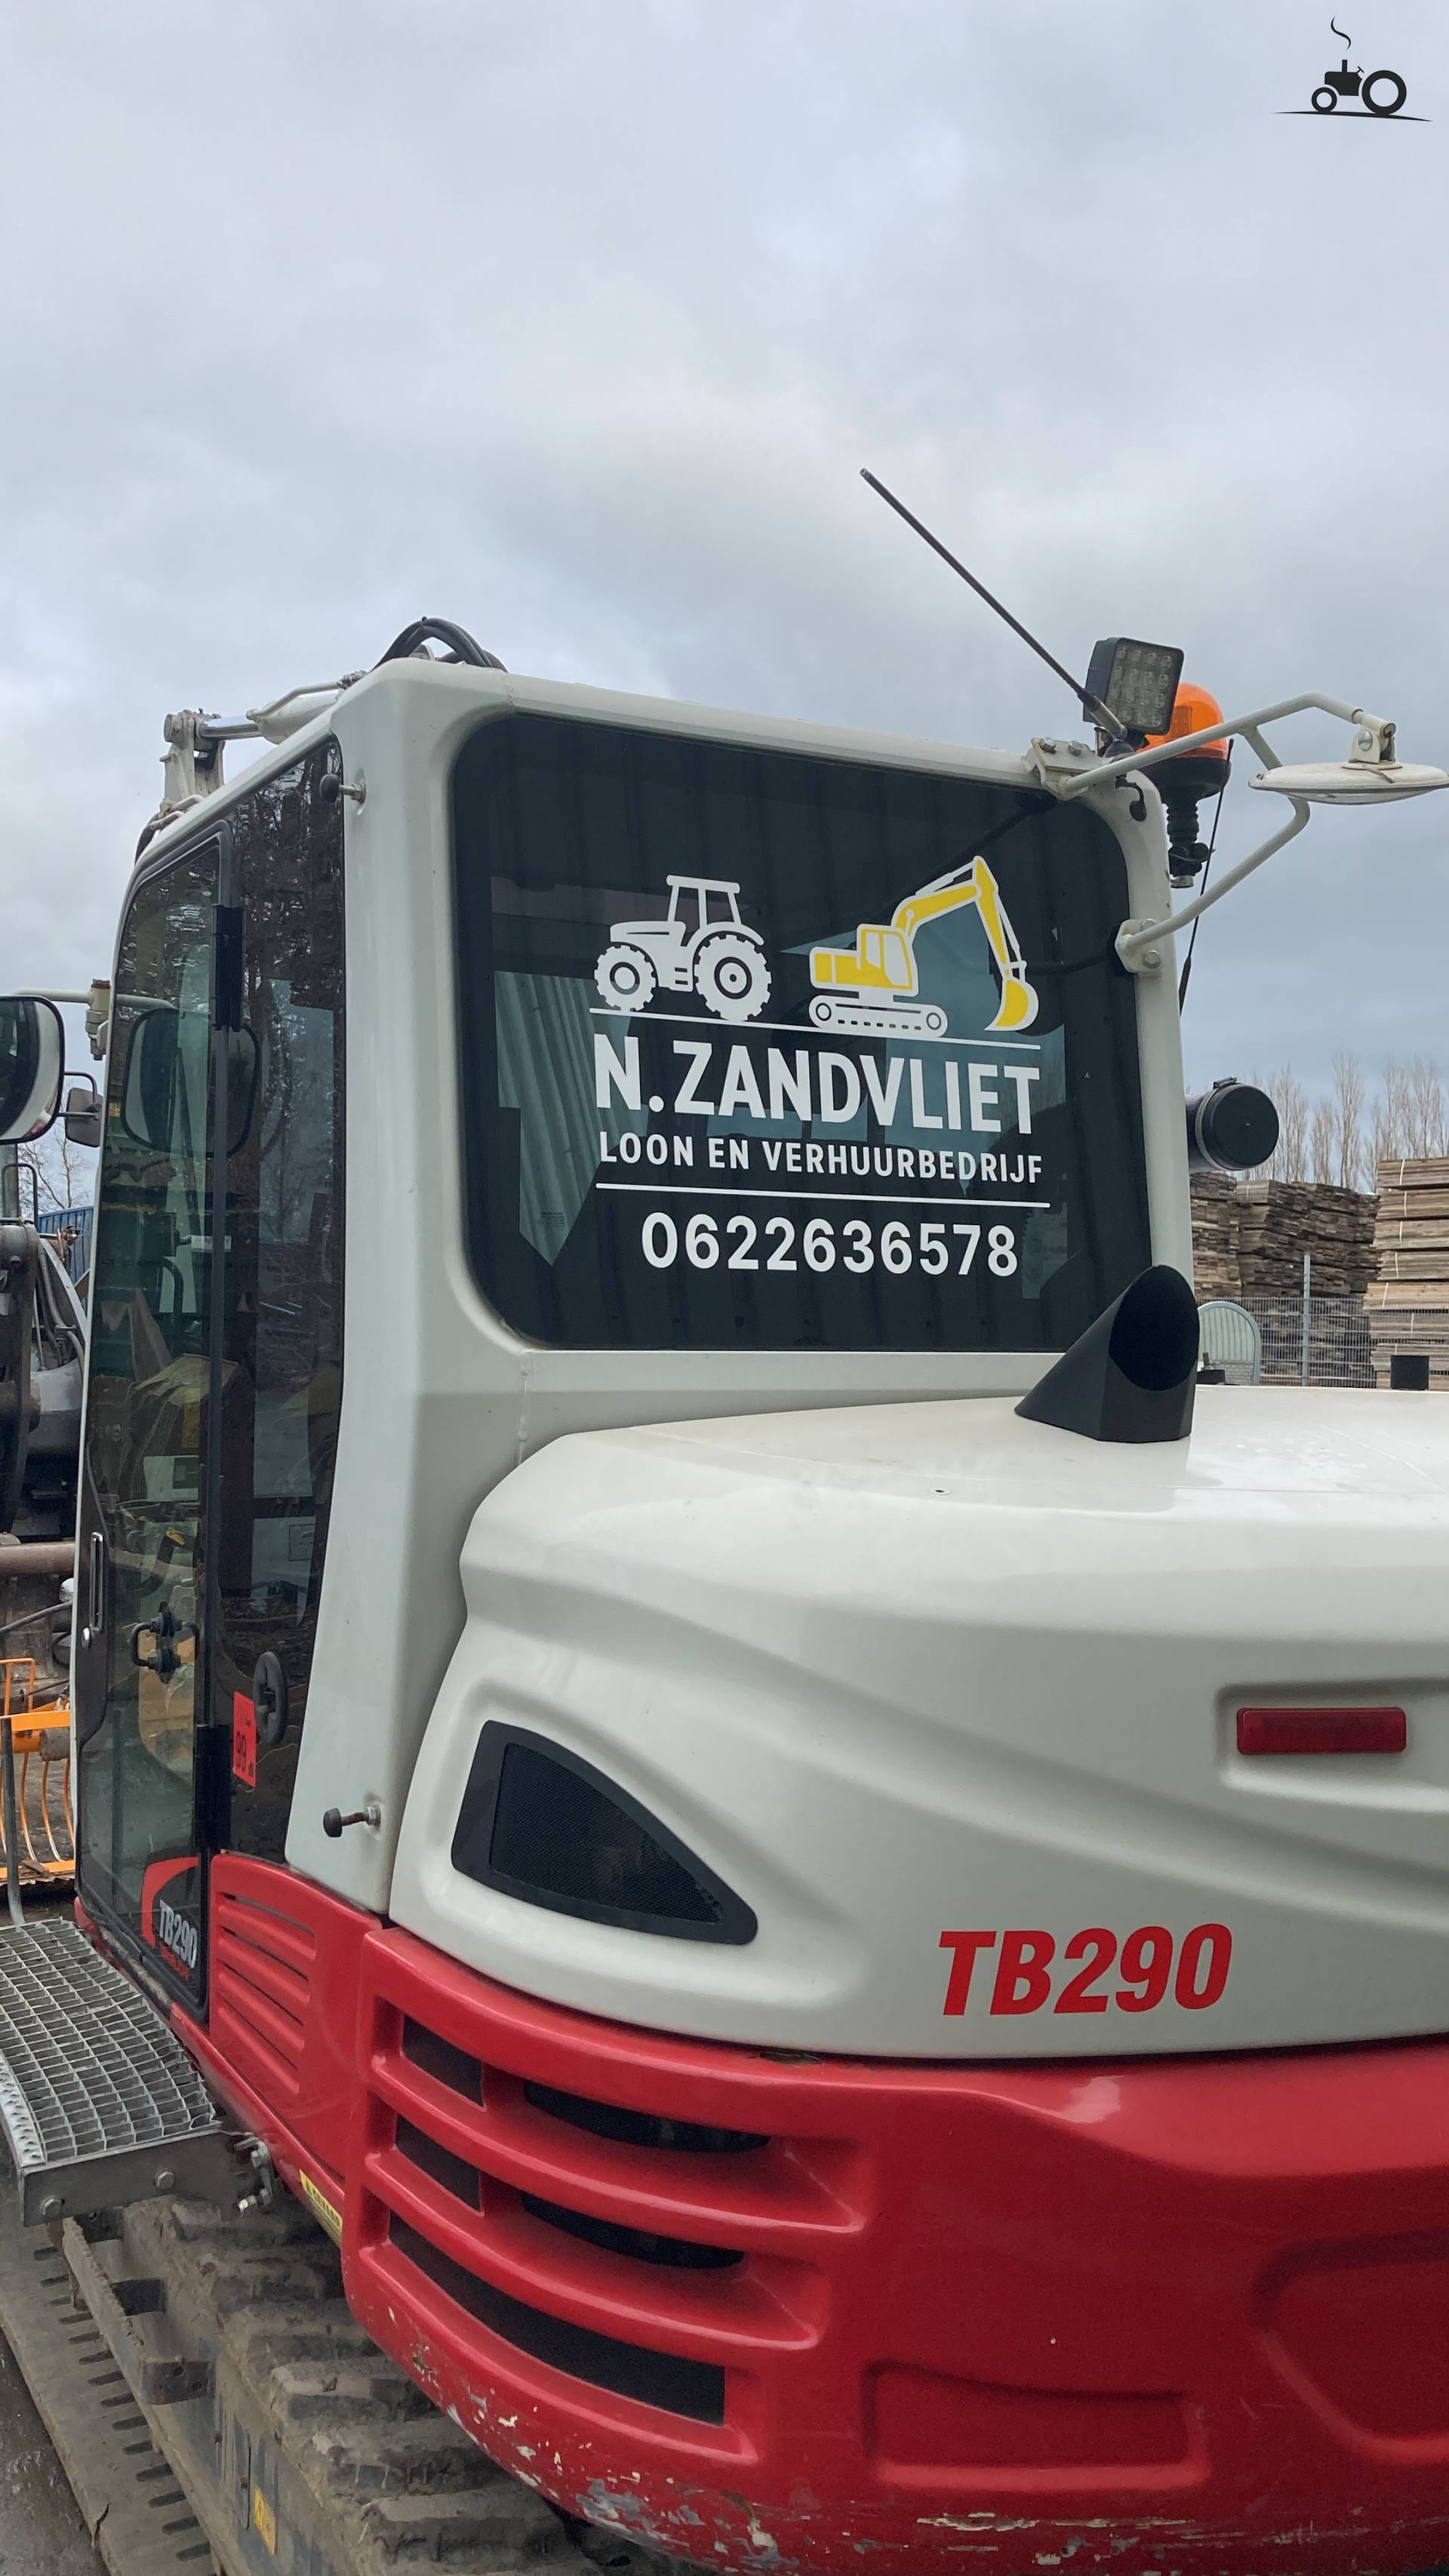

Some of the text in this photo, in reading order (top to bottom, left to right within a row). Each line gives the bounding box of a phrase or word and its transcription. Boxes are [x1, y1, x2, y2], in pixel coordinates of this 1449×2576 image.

[600, 1131, 1042, 1183] LOON EN VERHUURBEDRIJF
[641, 1212, 1018, 1277] 0622636578
[159, 1899, 198, 1968] TB290
[939, 1924, 1232, 2016] TB290
